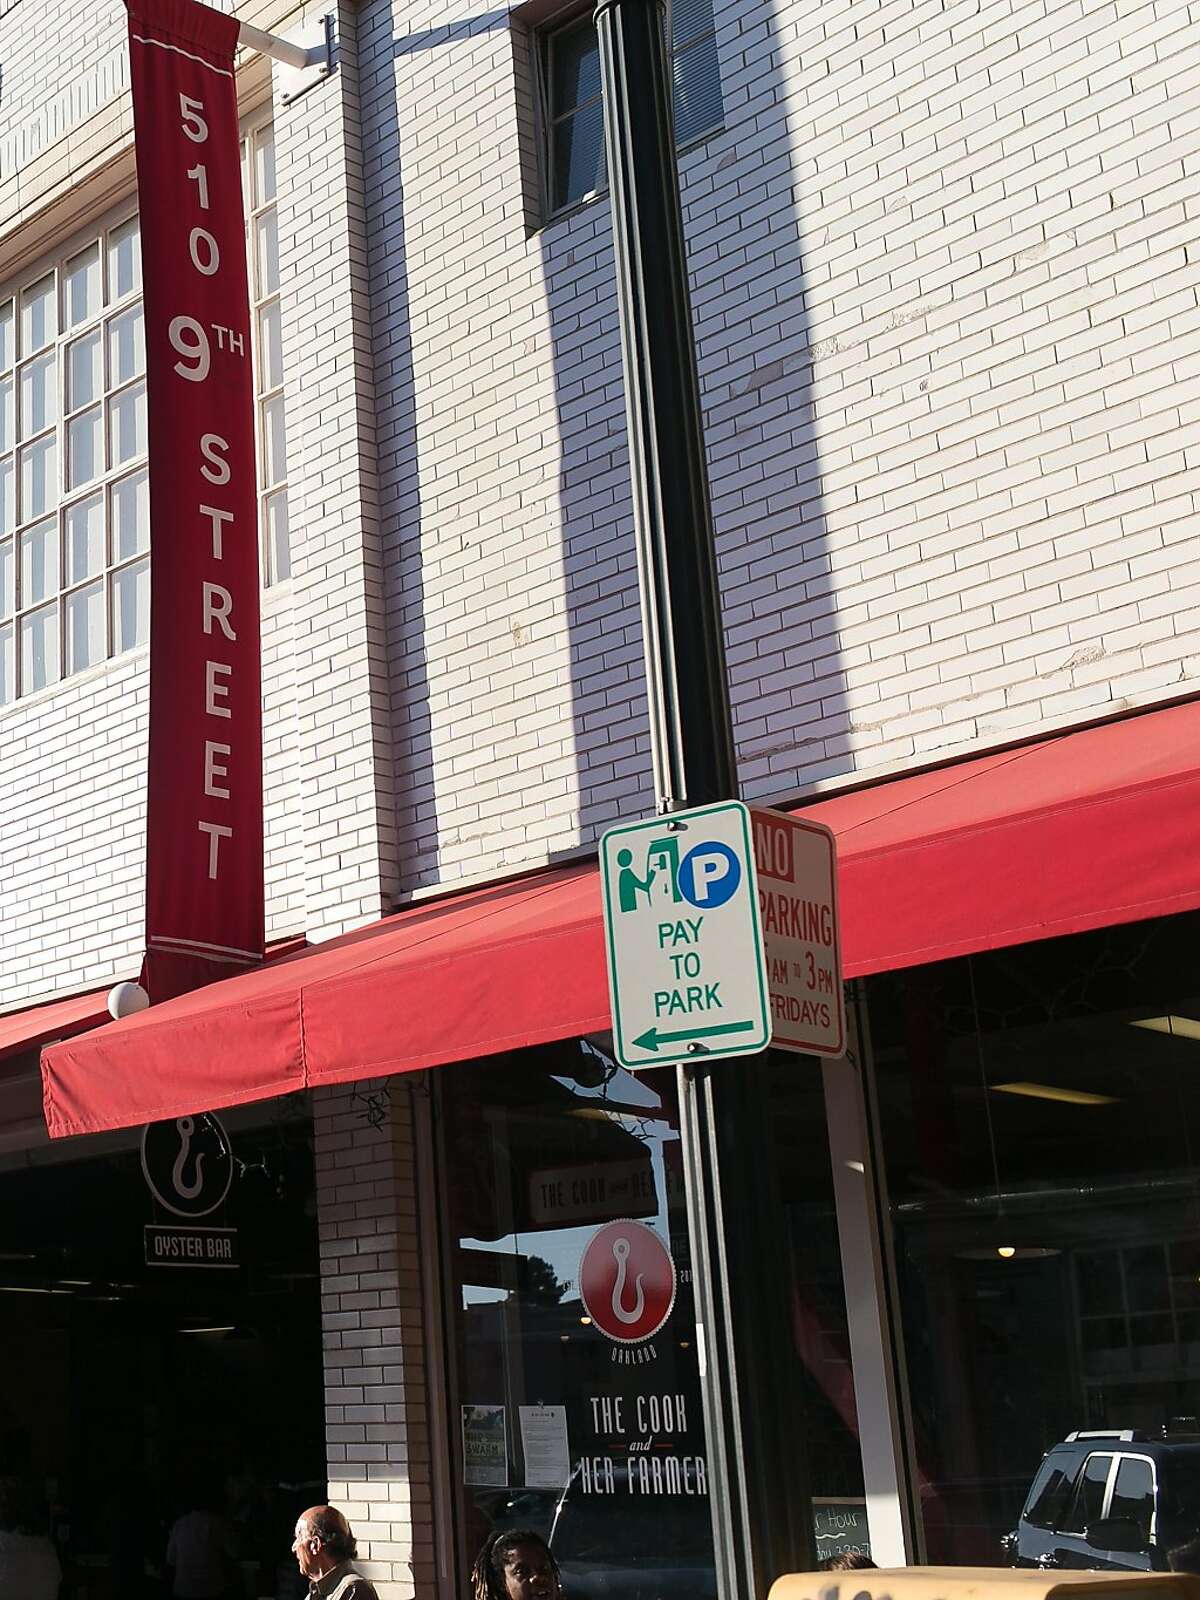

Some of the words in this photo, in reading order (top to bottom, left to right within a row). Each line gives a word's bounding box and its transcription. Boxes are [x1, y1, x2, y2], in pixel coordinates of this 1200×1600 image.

[179, 92, 220, 276] 510
[168, 315, 245, 382] 9TH
[198, 433, 237, 880] STREET
[757, 822, 788, 877] NO
[692, 852, 730, 901] P
[658, 916, 704, 949] PAY
[669, 952, 700, 979] TO
[655, 982, 723, 1017] PARK
[154, 1235, 203, 1257] OYSTER
[206, 1238, 232, 1258] BAR
[611, 1344, 657, 1365] OAKLAND
[590, 1396, 625, 1433] THE
[636, 1395, 687, 1433] COOK
[629, 1435, 652, 1451] and
[580, 1457, 615, 1494] HER
[627, 1456, 708, 1495] FARMER
[827, 1508, 862, 1528] Hour
